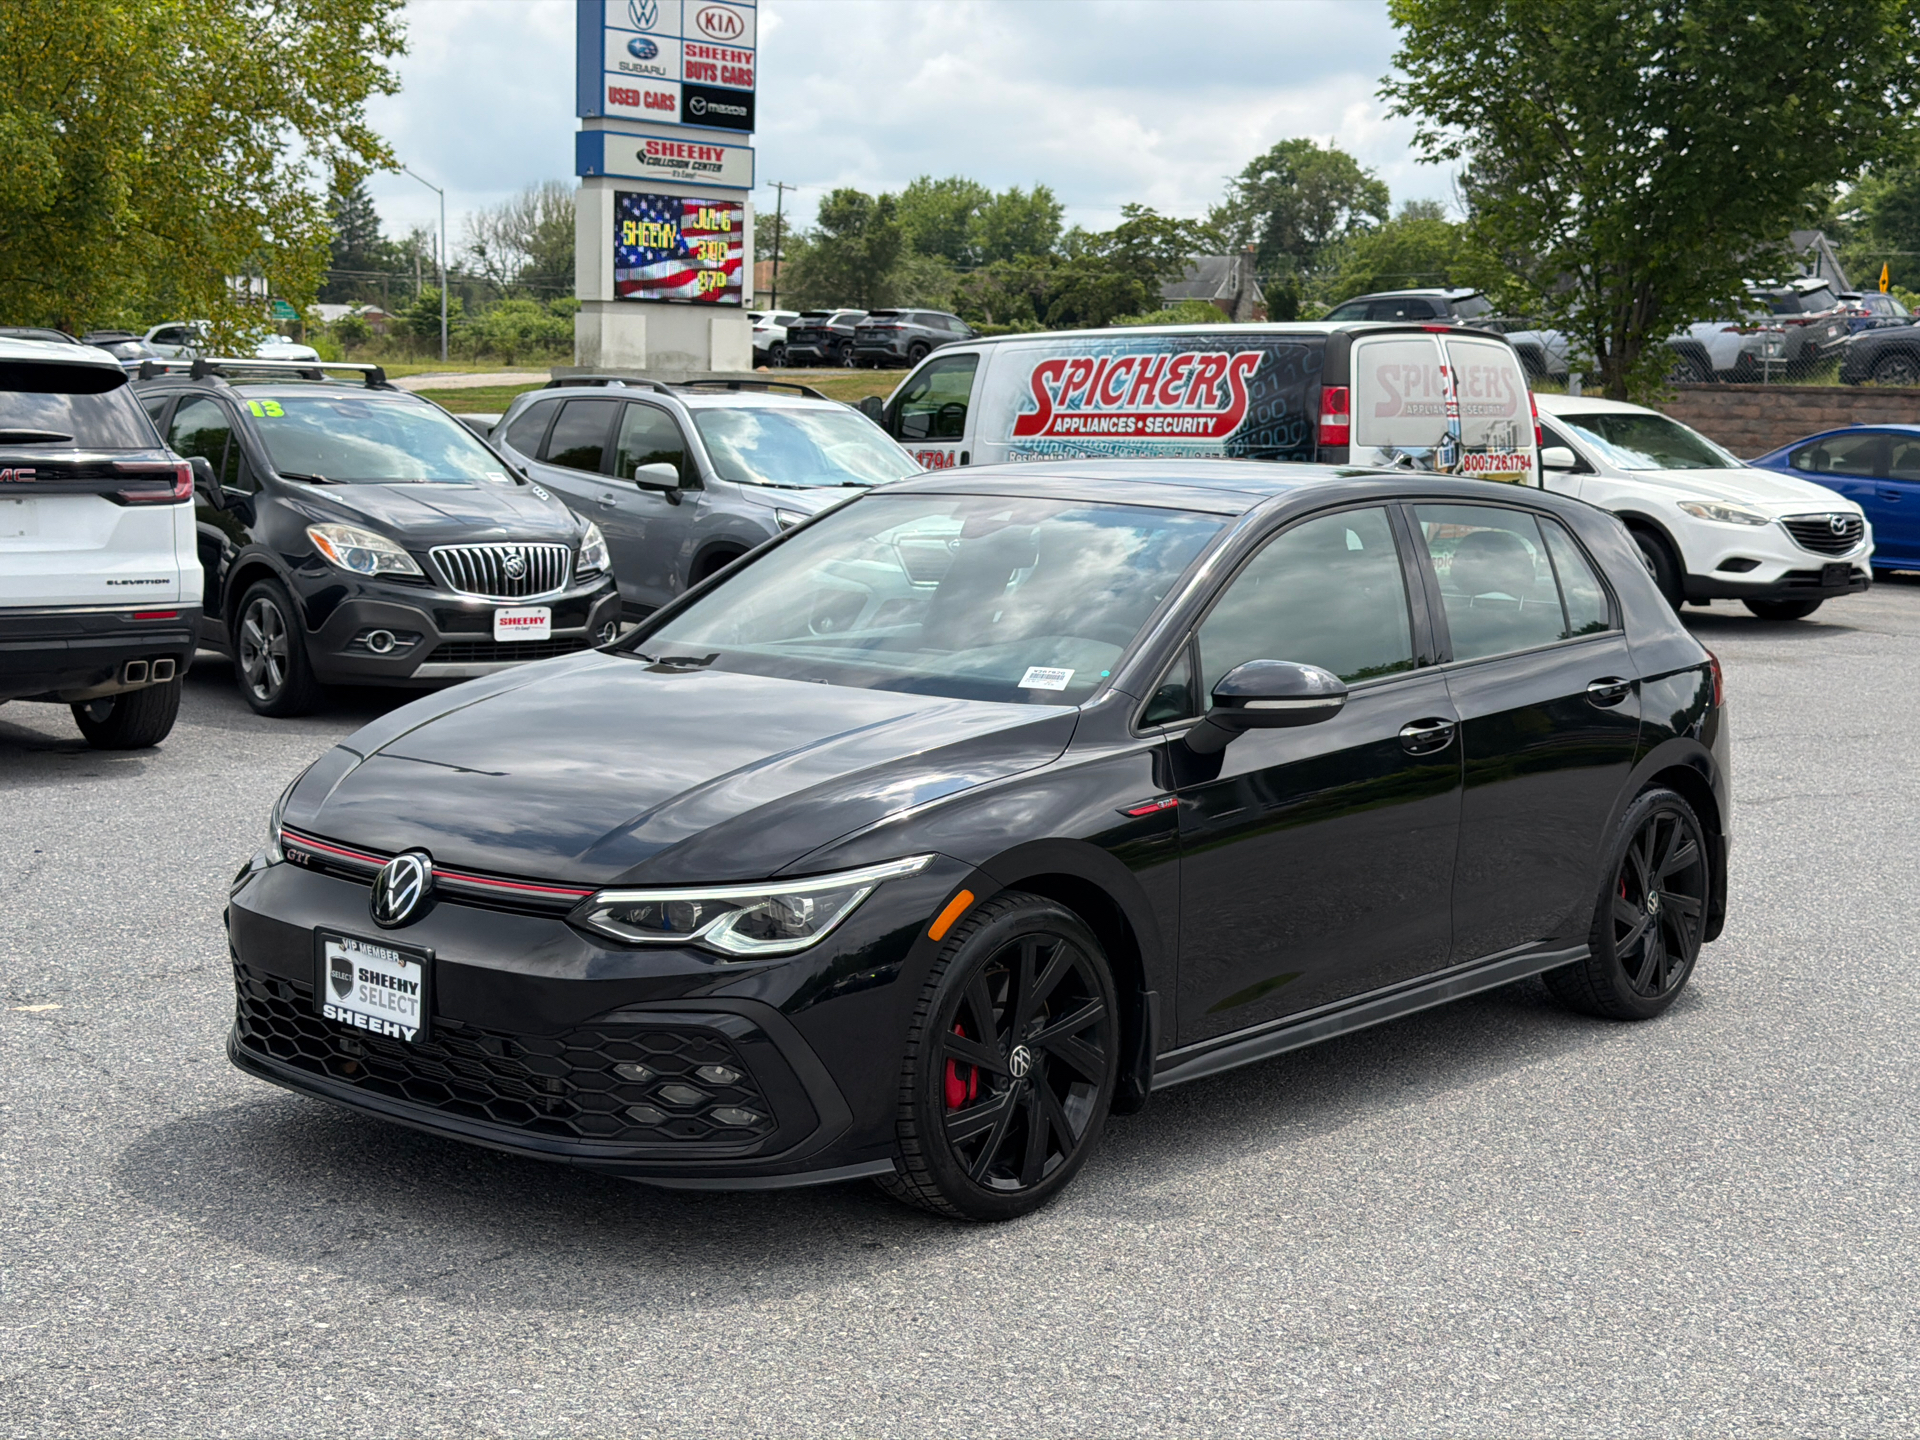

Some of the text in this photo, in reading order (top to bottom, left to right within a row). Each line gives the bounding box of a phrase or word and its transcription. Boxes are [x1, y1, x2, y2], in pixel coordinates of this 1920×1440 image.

[704, 12, 737, 34] KIA
[685, 44, 753, 65] SHEEHY
[619, 61, 666, 76] SUBARU
[685, 60, 753, 87] BUYS CARS
[608, 86, 676, 111] USED CARS
[707, 103, 748, 116] mazda
[646, 140, 725, 162] SHEEHY
[646, 156, 723, 172] COLLISION CENTER
[623, 220, 677, 249] SHEEHY
[1013, 351, 1265, 438] SPICHERS
[1375, 364, 1518, 418] SPICHERS
[246, 400, 285, 418] 13
[1053, 416, 1217, 434] APPLIANCES SECURITY
[906, 449, 956, 470] 1794
[1463, 454, 1532, 472] 800.726.1794
[106, 578, 170, 586] ELEVATION
[499, 616, 546, 626] SHEEHY
[286, 848, 311, 865] GTI
[341, 937, 400, 963] VIP MEMBER
[331, 969, 353, 982] SELECT
[358, 967, 419, 996] SHEEHY
[358, 983, 419, 1017] SELECT
[322, 1004, 418, 1042] SHEEHY
